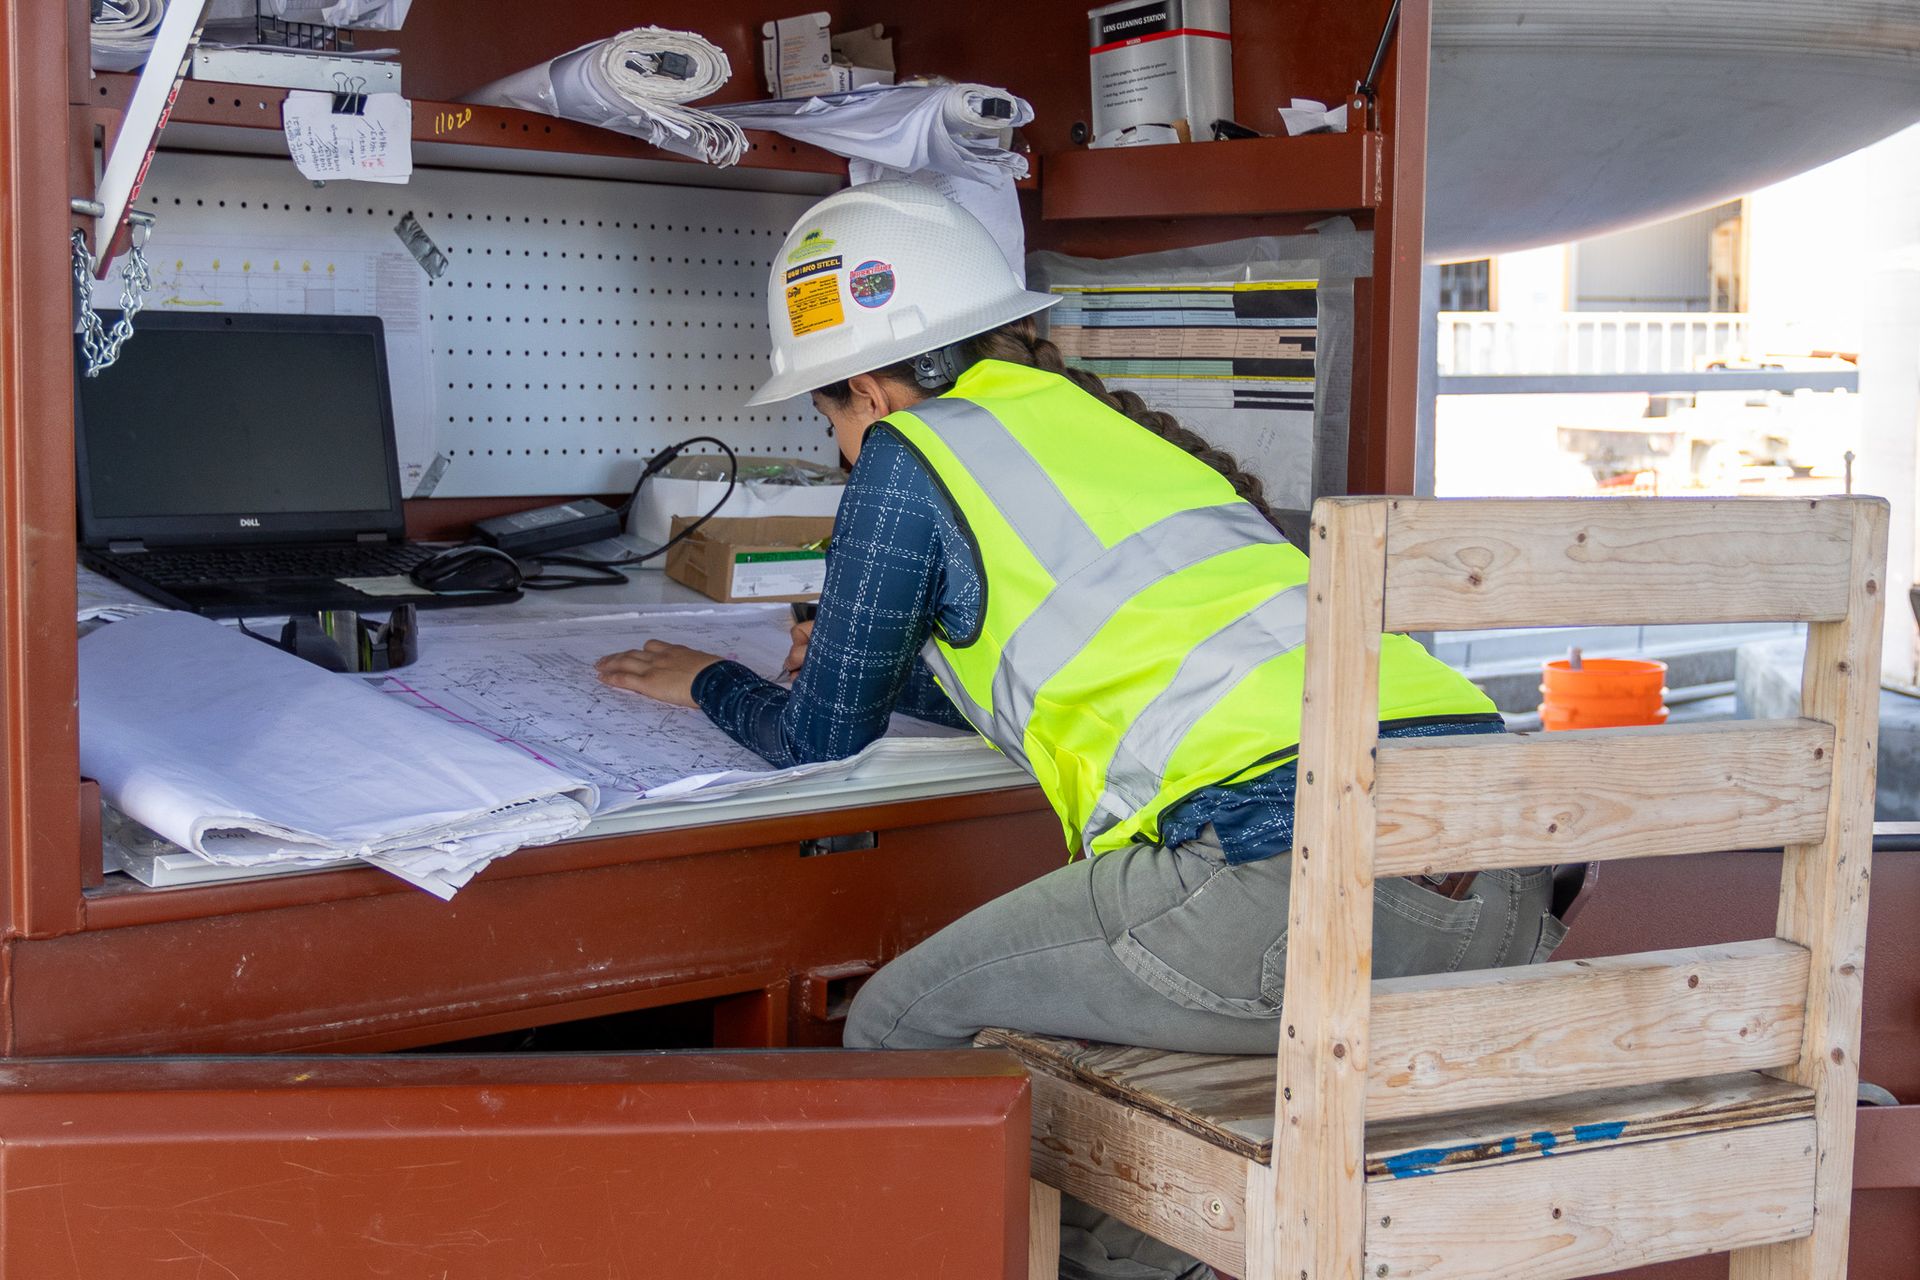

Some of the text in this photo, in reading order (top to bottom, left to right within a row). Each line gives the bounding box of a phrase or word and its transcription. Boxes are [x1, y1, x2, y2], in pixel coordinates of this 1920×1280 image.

[1103, 12, 1167, 33] LENS CLEANING STATION
[435, 108, 472, 134] 11020
[816, 258, 841, 270] STEEL
[240, 518, 261, 527] DELL
